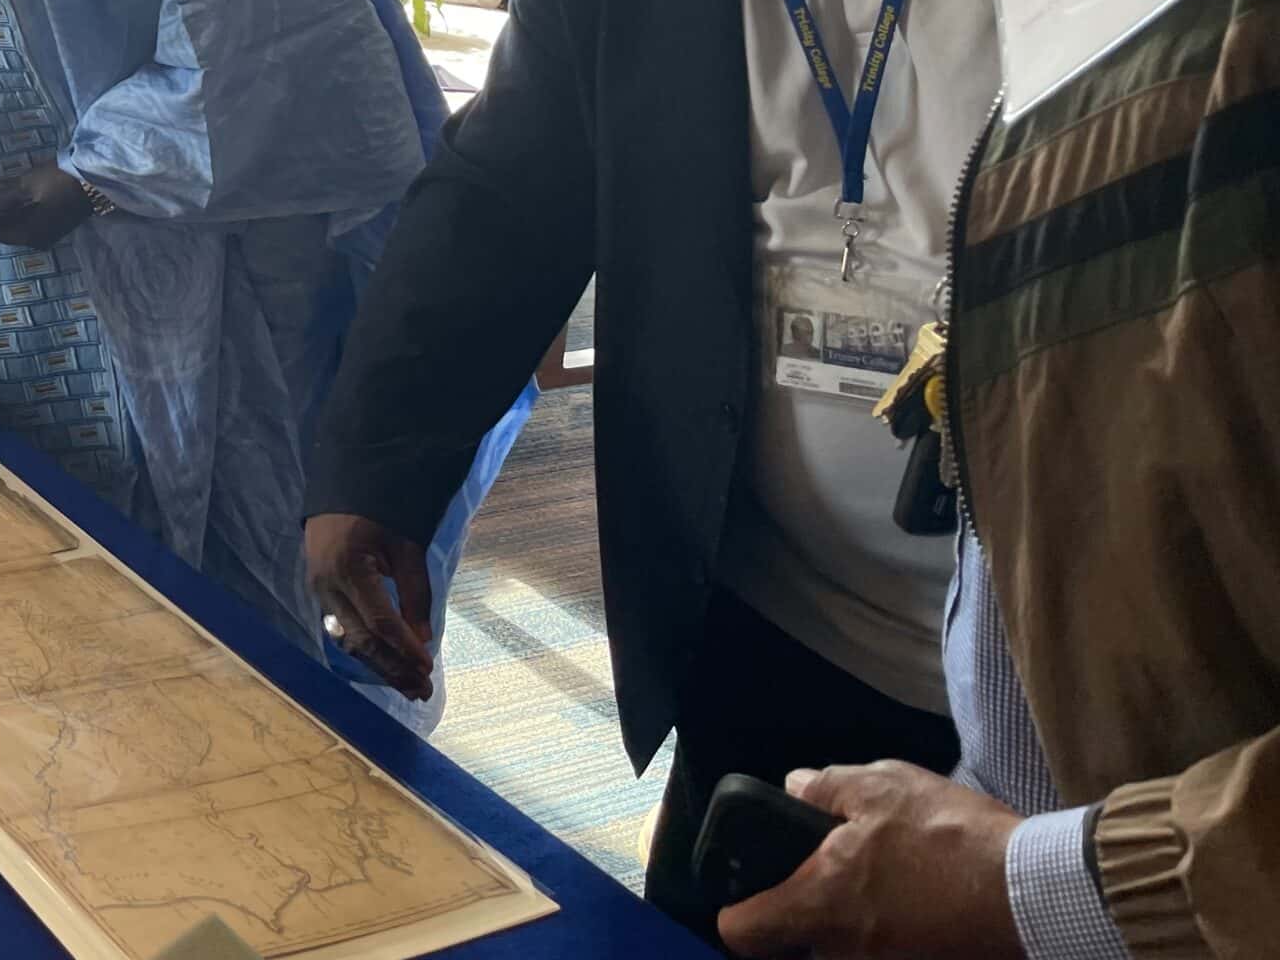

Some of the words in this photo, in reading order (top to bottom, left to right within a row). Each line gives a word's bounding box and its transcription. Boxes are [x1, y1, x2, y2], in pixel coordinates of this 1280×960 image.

[794, 8, 816, 48] Trinity
[811, 48, 833, 89] College
[864, 50, 884, 92] Trinity
[875, 5, 895, 49] College
